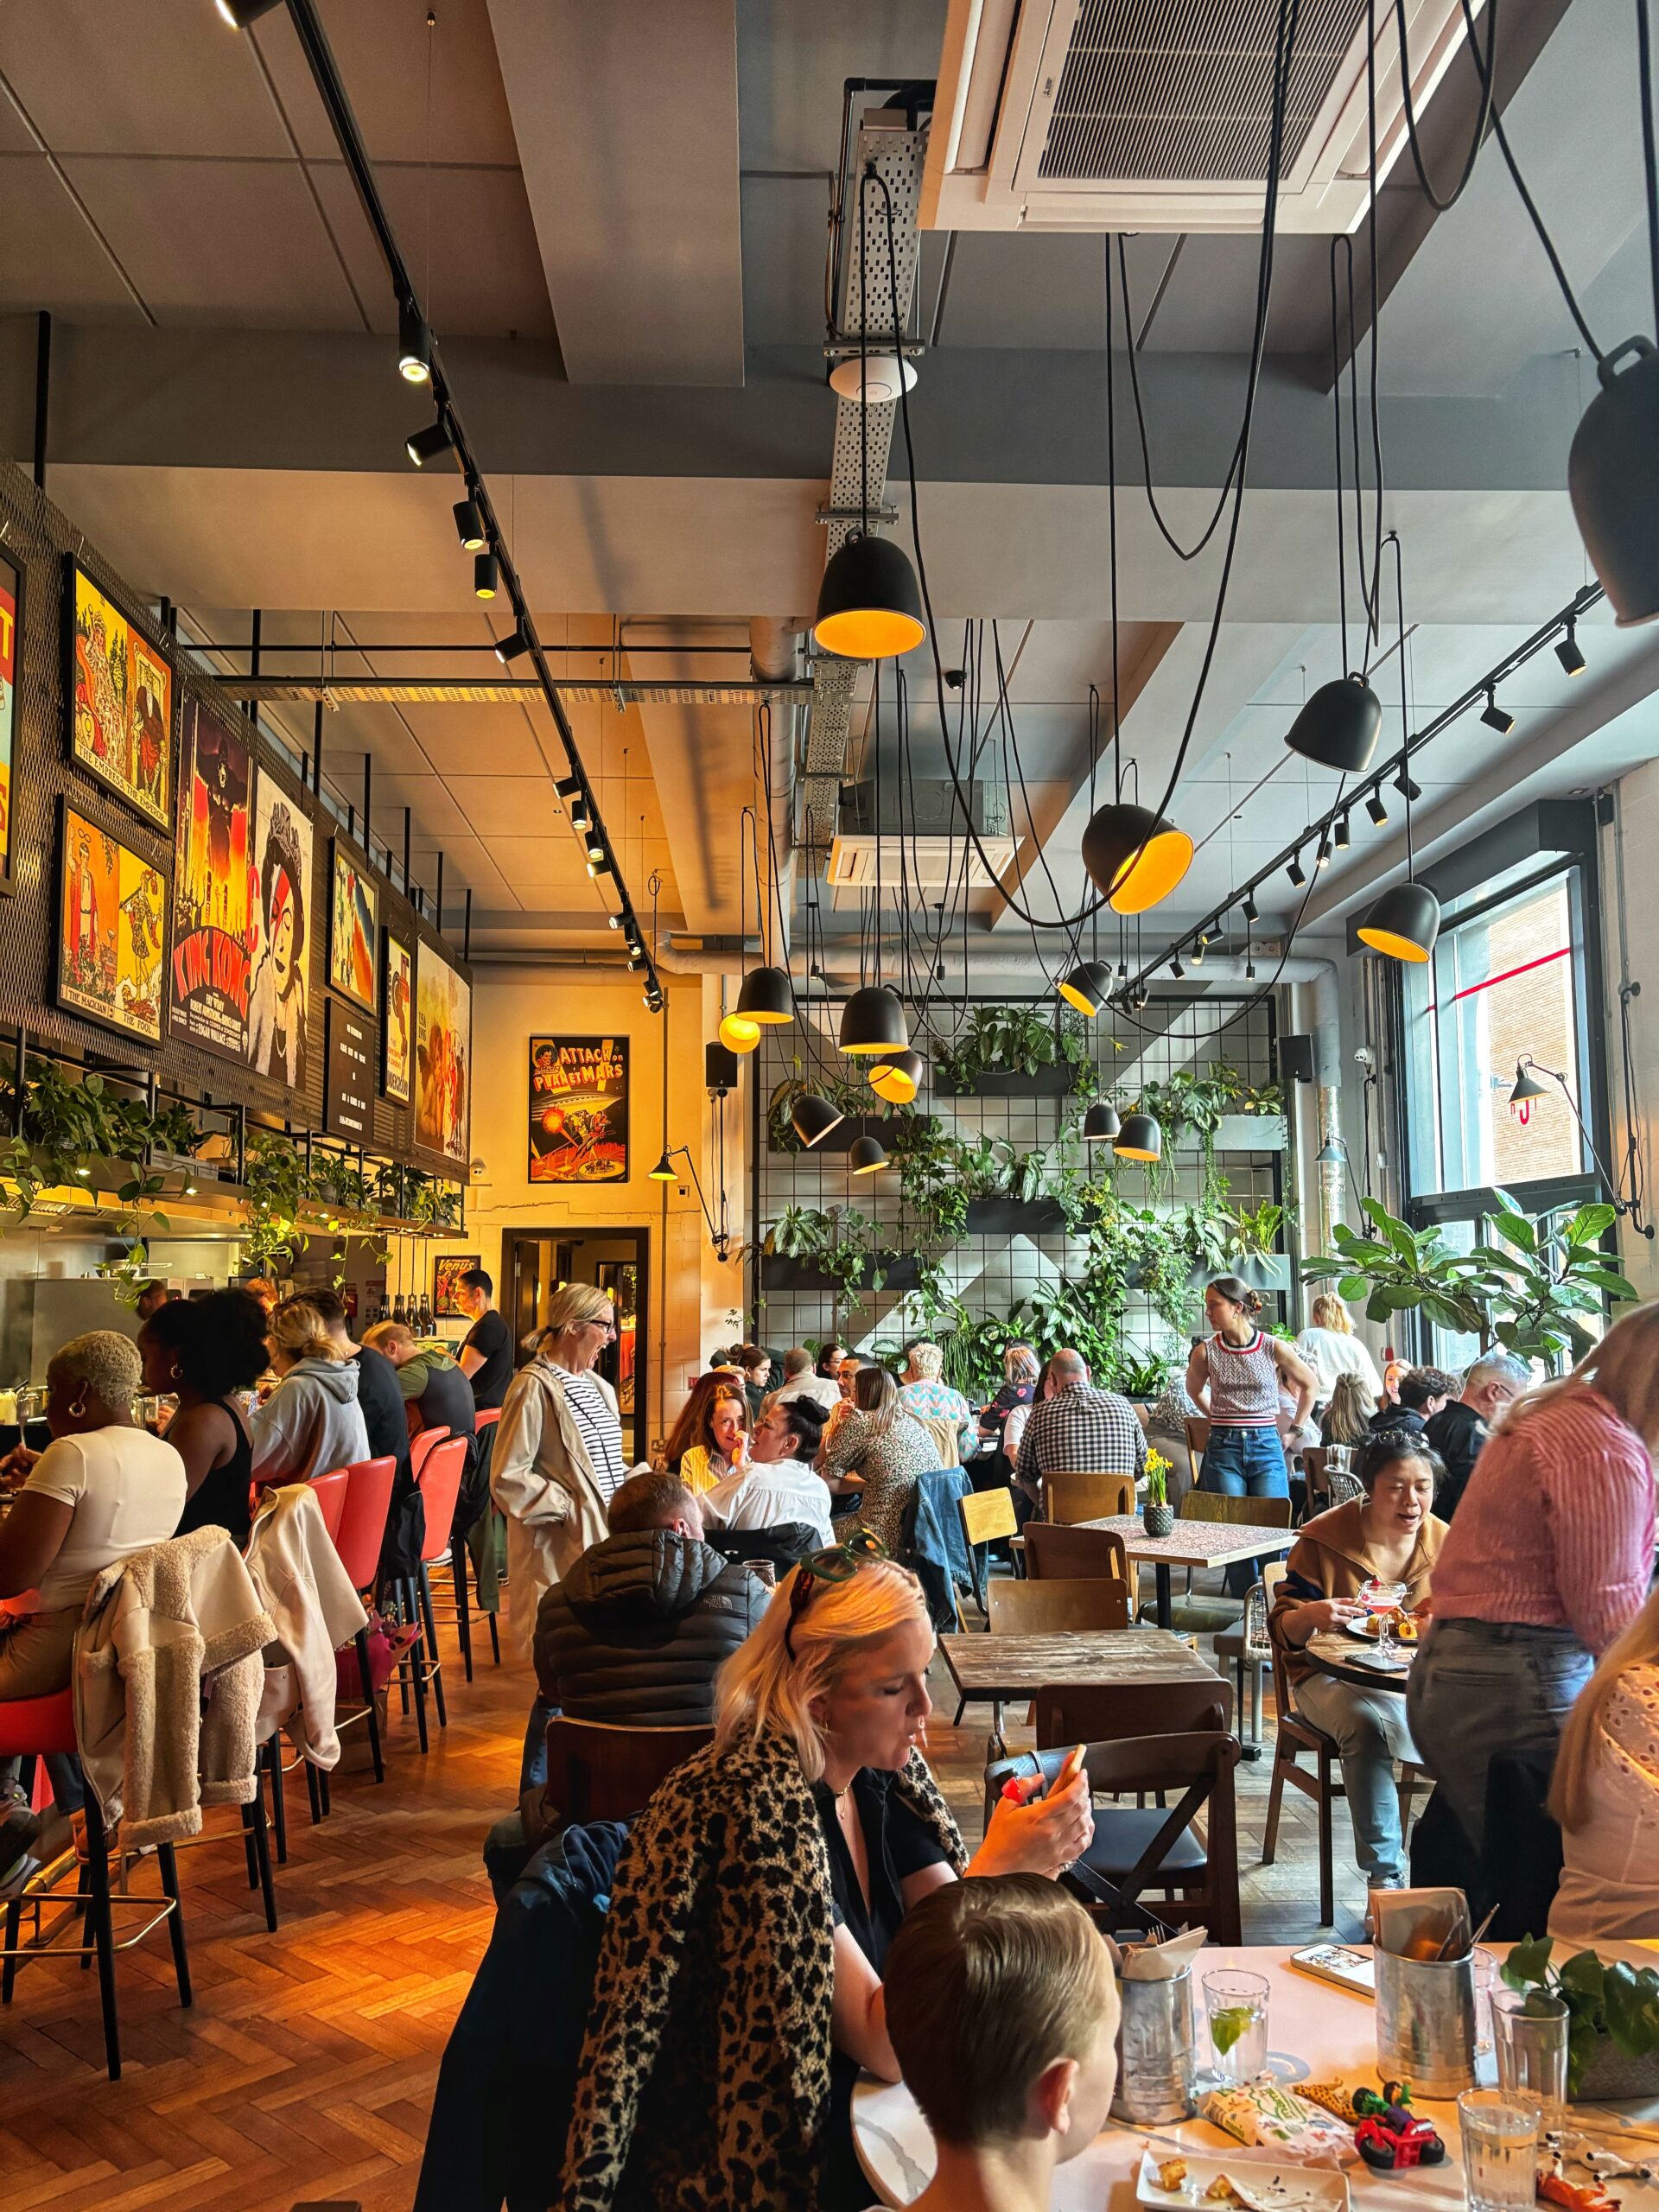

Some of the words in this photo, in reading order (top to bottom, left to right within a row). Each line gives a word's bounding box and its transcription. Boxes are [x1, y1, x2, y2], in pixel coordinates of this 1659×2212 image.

[79, 745, 92, 762] THE
[126, 784, 138, 801] THE
[173, 929, 211, 1003] KING
[212, 929, 251, 1022] KONG
[68, 989, 80, 1003] THE
[81, 994, 107, 1014] MAGICIAN
[124, 1013, 136, 1027] THE
[198, 1023, 210, 1039] EDGAR
[559, 1046, 611, 1065] ATTACK
[533, 1072, 582, 1092] PLANET
[580, 1064, 624, 1083] MARS
